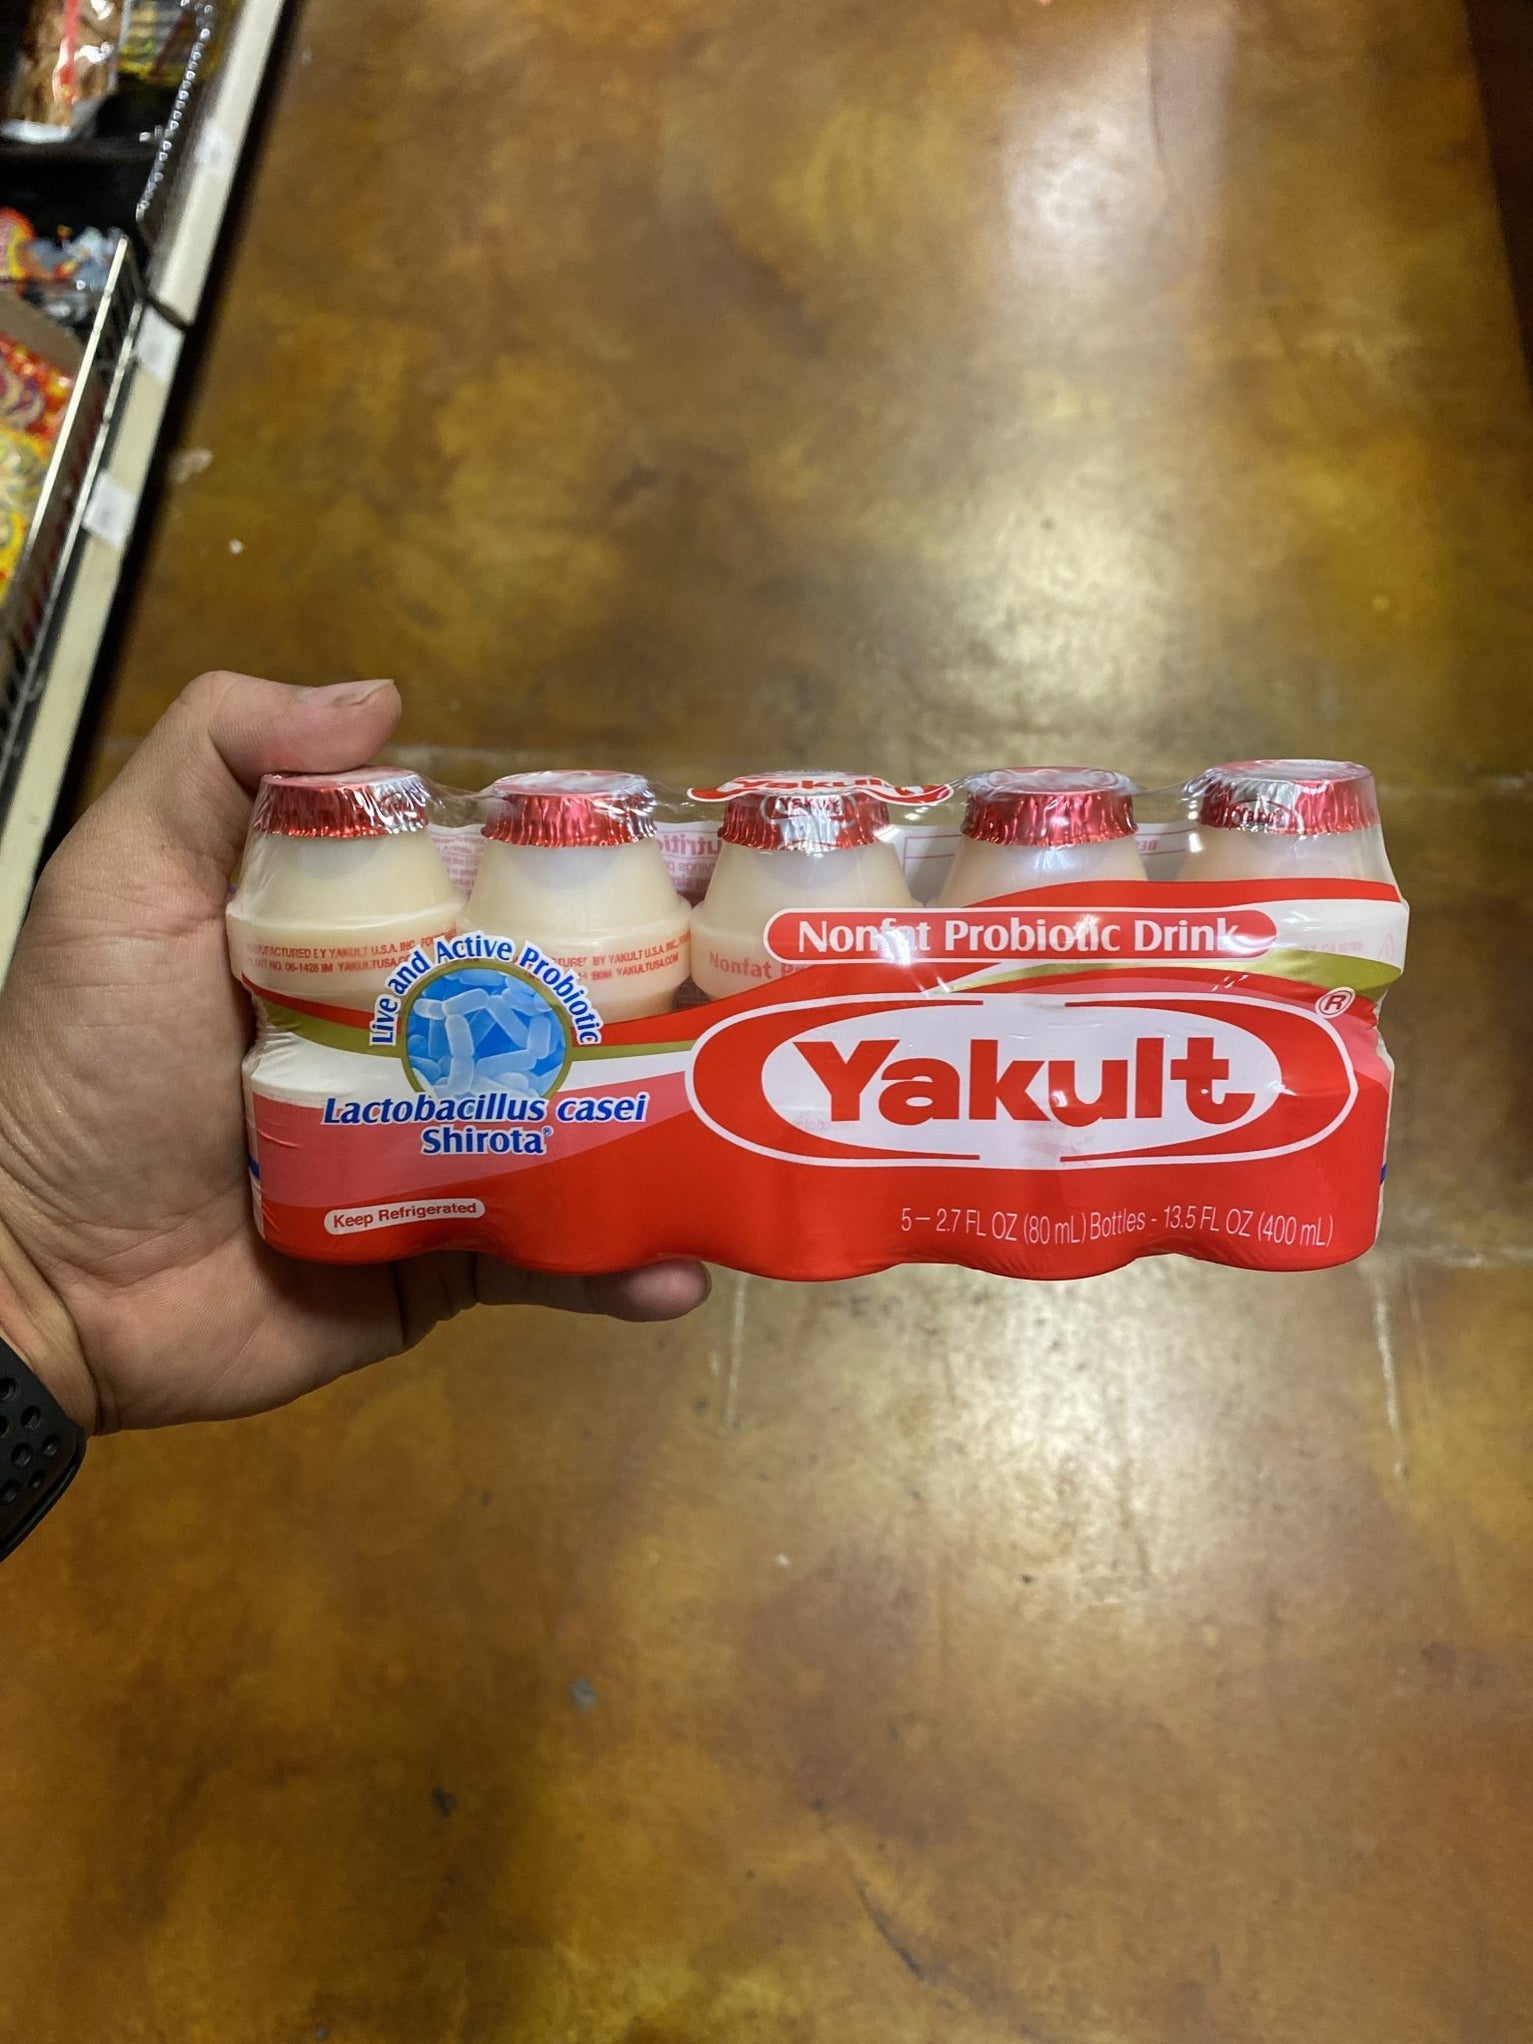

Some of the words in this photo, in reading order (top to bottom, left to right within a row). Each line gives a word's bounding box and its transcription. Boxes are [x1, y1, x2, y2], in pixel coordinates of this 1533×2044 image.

[799, 917, 930, 953] Nonfat
[945, 917, 1120, 953] Probiotic
[1134, 917, 1240, 952] Drink
[337, 954, 411, 973] YAKULTUSA.CO
[592, 955, 606, 967] BY
[608, 949, 643, 965] YAKULT
[709, 950, 773, 979] Nonfat
[372, 997, 398, 1045] Live
[387, 952, 432, 994] and
[434, 935, 513, 964] Active
[519, 947, 601, 1044] Probiotic
[793, 1036, 1256, 1128] Yakult
[323, 1093, 546, 1124] Lactobacillus
[557, 1094, 647, 1121] casei
[333, 1211, 374, 1229] Keep
[378, 1202, 477, 1222] Refrigerated
[966, 1209, 987, 1237] FL
[992, 1211, 1018, 1241] OZ
[1024, 1213, 1050, 1244] (80
[1055, 1217, 1087, 1244] mL)
[1090, 1209, 1146, 1240] Bottles
[1164, 1205, 1197, 1229] 13.5
[1200, 1206, 1221, 1232] FL
[1225, 1208, 1254, 1238] OZ
[1258, 1211, 1297, 1246] (400
[1301, 1214, 1334, 1248] mL)
